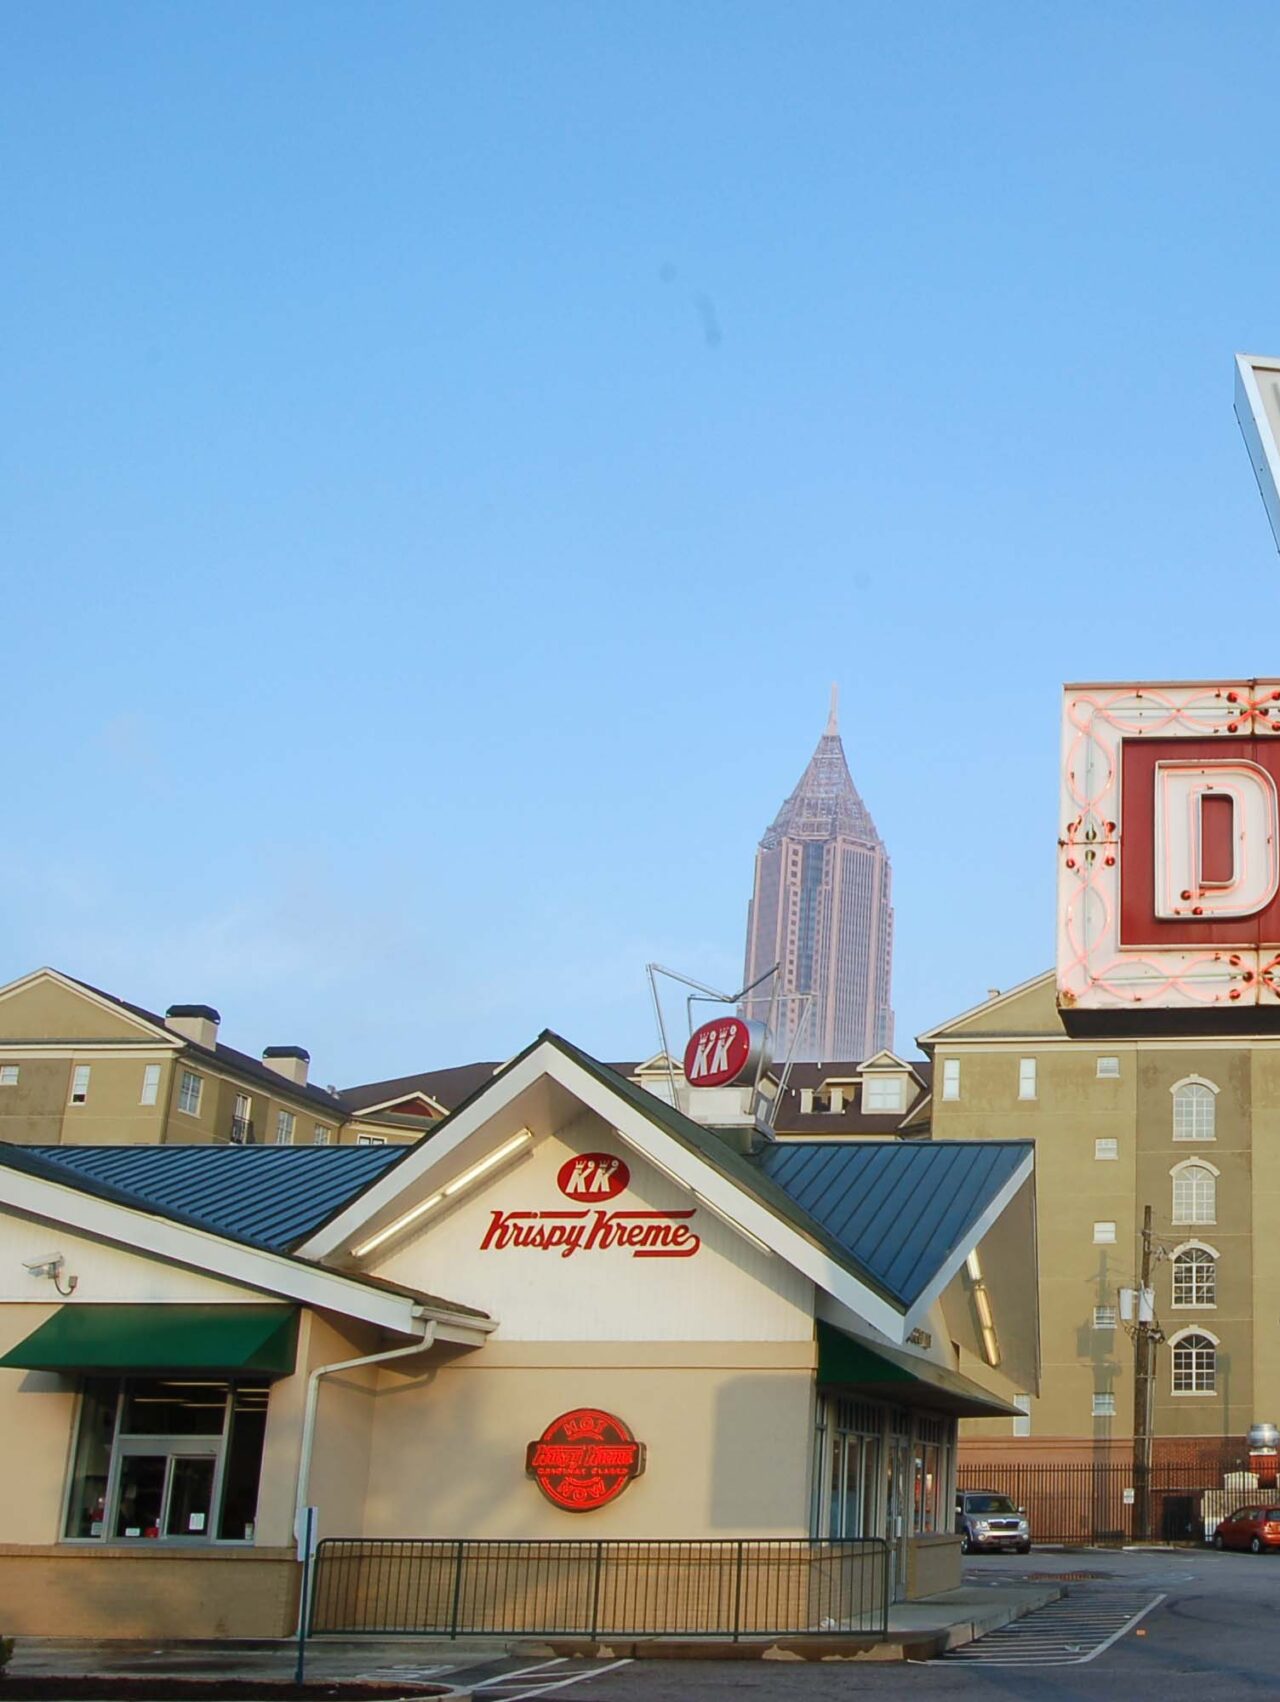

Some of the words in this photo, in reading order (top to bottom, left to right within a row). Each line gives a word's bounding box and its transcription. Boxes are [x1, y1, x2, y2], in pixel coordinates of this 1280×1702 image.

[690, 1025, 737, 1080] KK
[565, 1160, 619, 1194] KK
[479, 1209, 591, 1258] Krispy
[583, 1209, 700, 1258] Kreme
[563, 1416, 607, 1436] HOT
[557, 1480, 606, 1501] NOW
